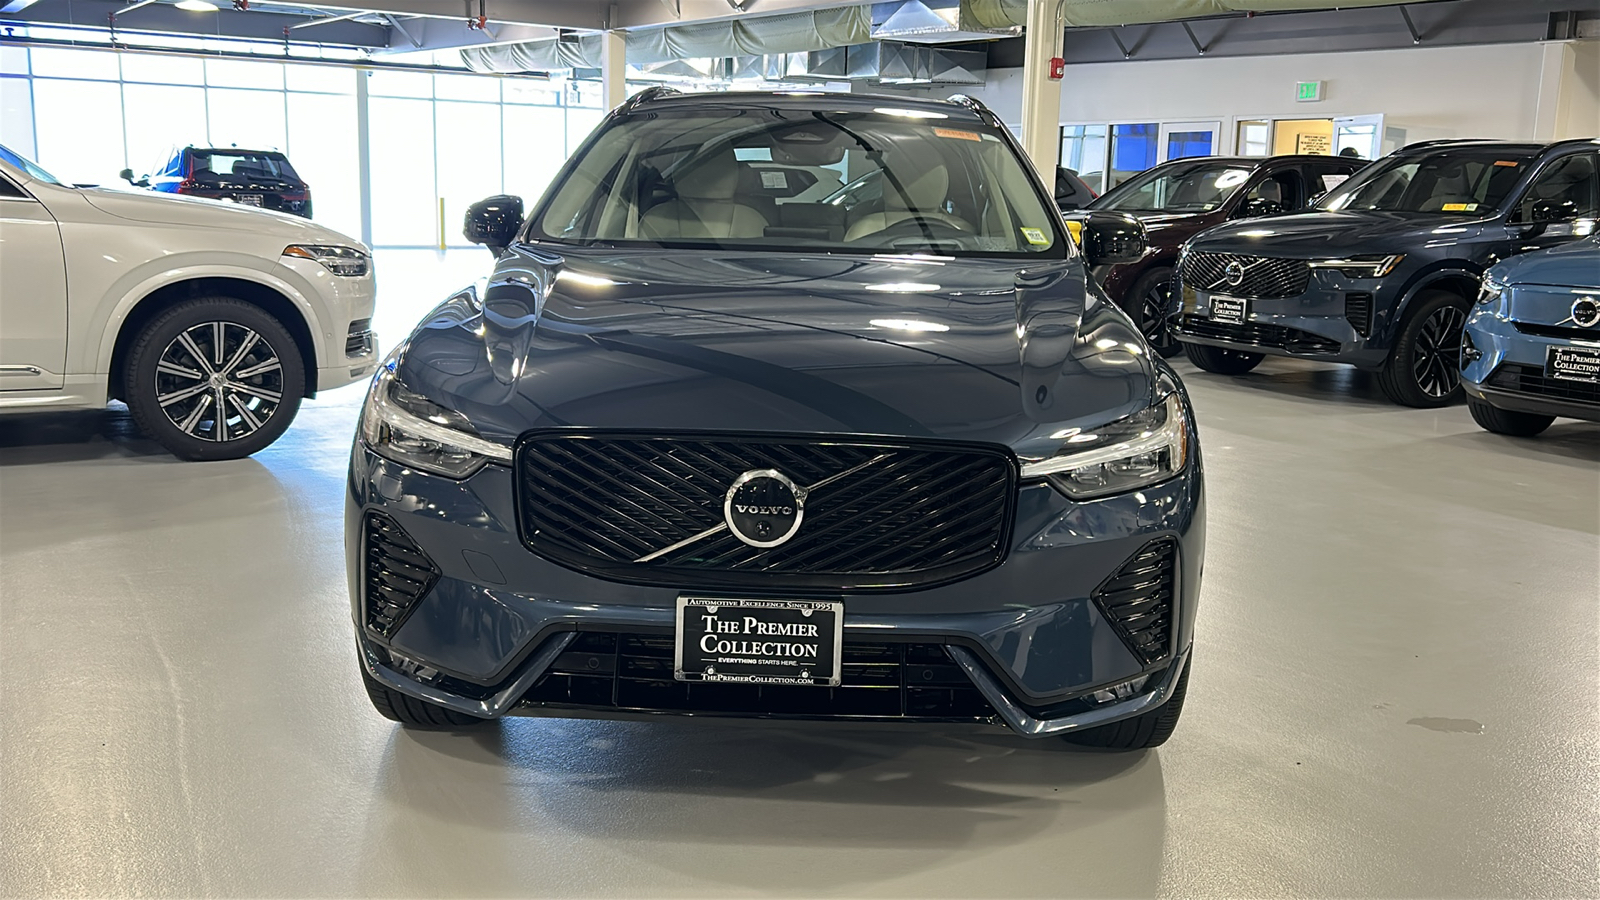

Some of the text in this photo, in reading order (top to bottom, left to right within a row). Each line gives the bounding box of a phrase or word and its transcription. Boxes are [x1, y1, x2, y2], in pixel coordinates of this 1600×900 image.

[1299, 82, 1317, 99] EXIT
[1555, 353, 1600, 364] THE PREMIER
[1554, 360, 1599, 372] COLLECTION
[735, 504, 793, 515] VOLVO
[740, 600, 785, 608] EXCELLENCE
[787, 601, 809, 609] SINCE
[811, 602, 831, 610] 1995
[701, 615, 818, 637] THE PREMIER
[700, 634, 818, 658] COLLECTION
[701, 673, 814, 684] THEPREMIERCOLLECTION.COM
